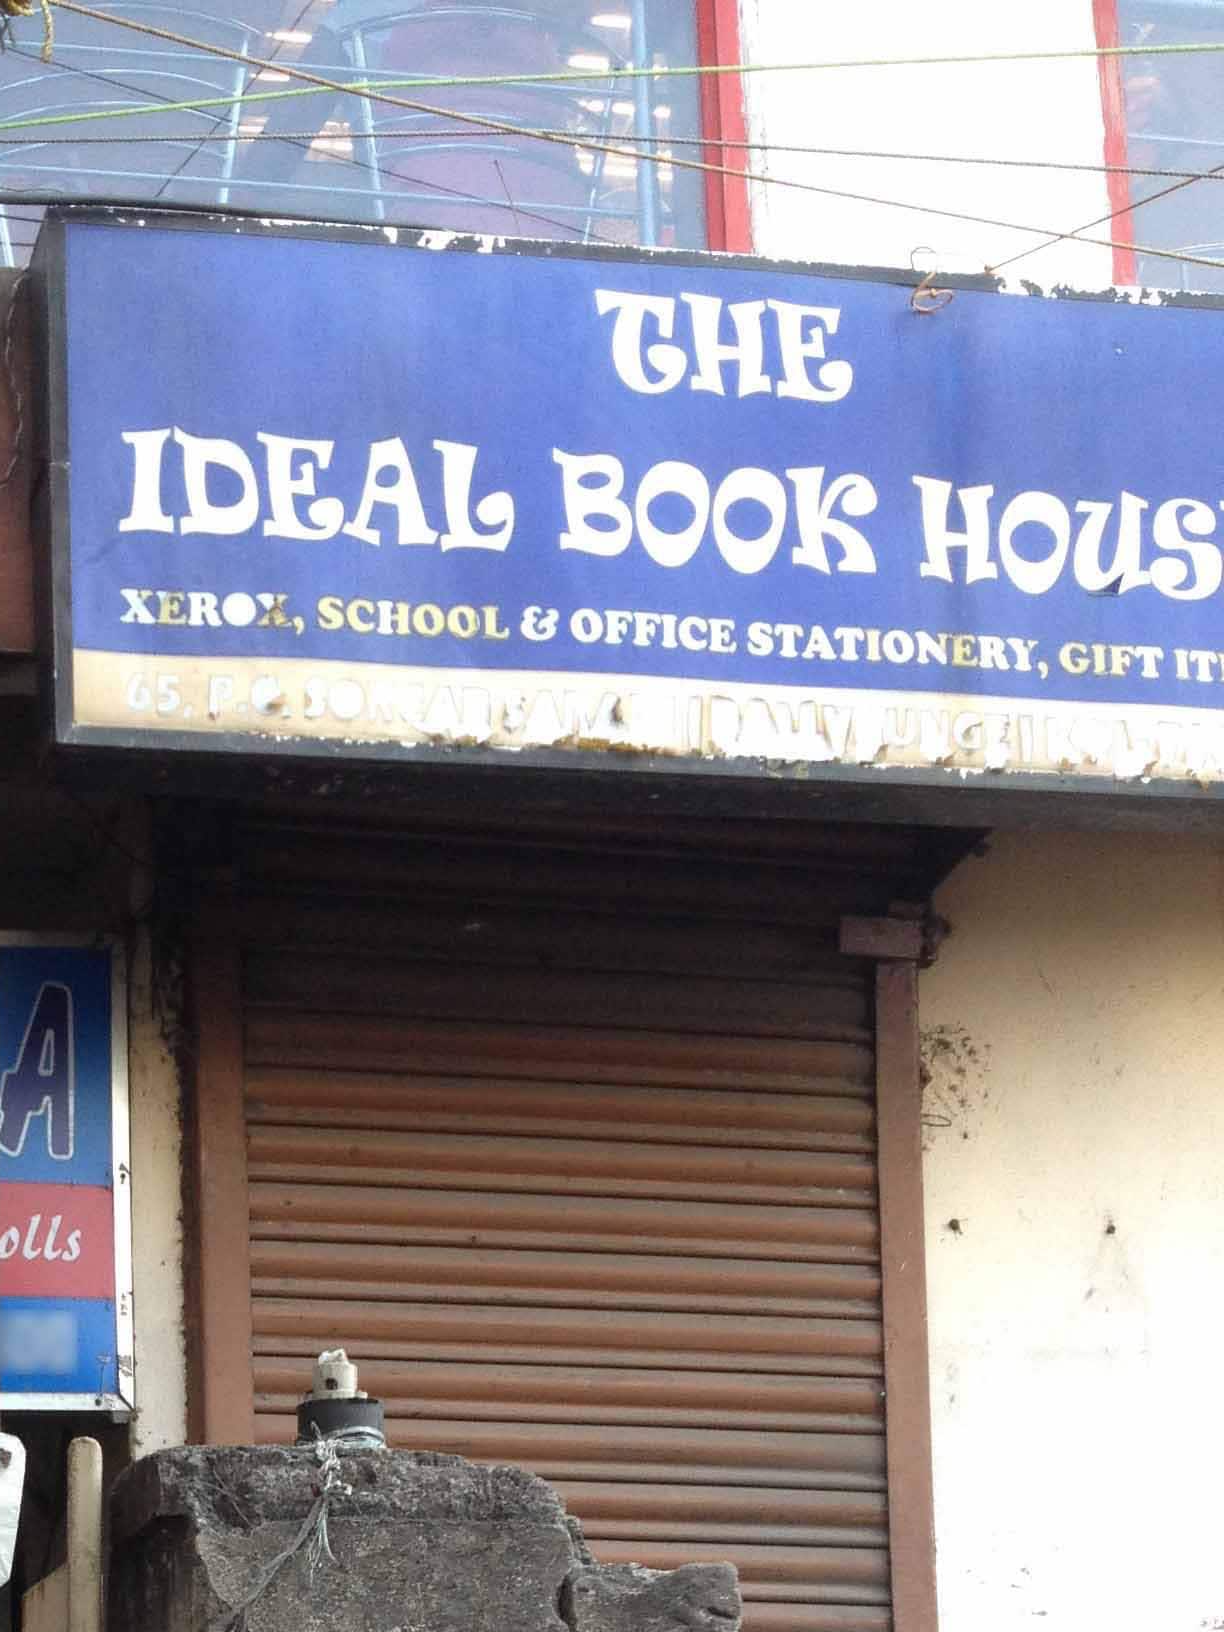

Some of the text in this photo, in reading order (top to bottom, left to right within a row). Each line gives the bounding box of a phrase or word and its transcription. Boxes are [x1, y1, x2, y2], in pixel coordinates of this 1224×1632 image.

[594, 287, 853, 402] THE
[119, 425, 1223, 601] IDEAL BOOK HOUS
[120, 587, 1223, 683] XEROX, SCHOOL & OFFICE STATIONERY, GIFT IT
